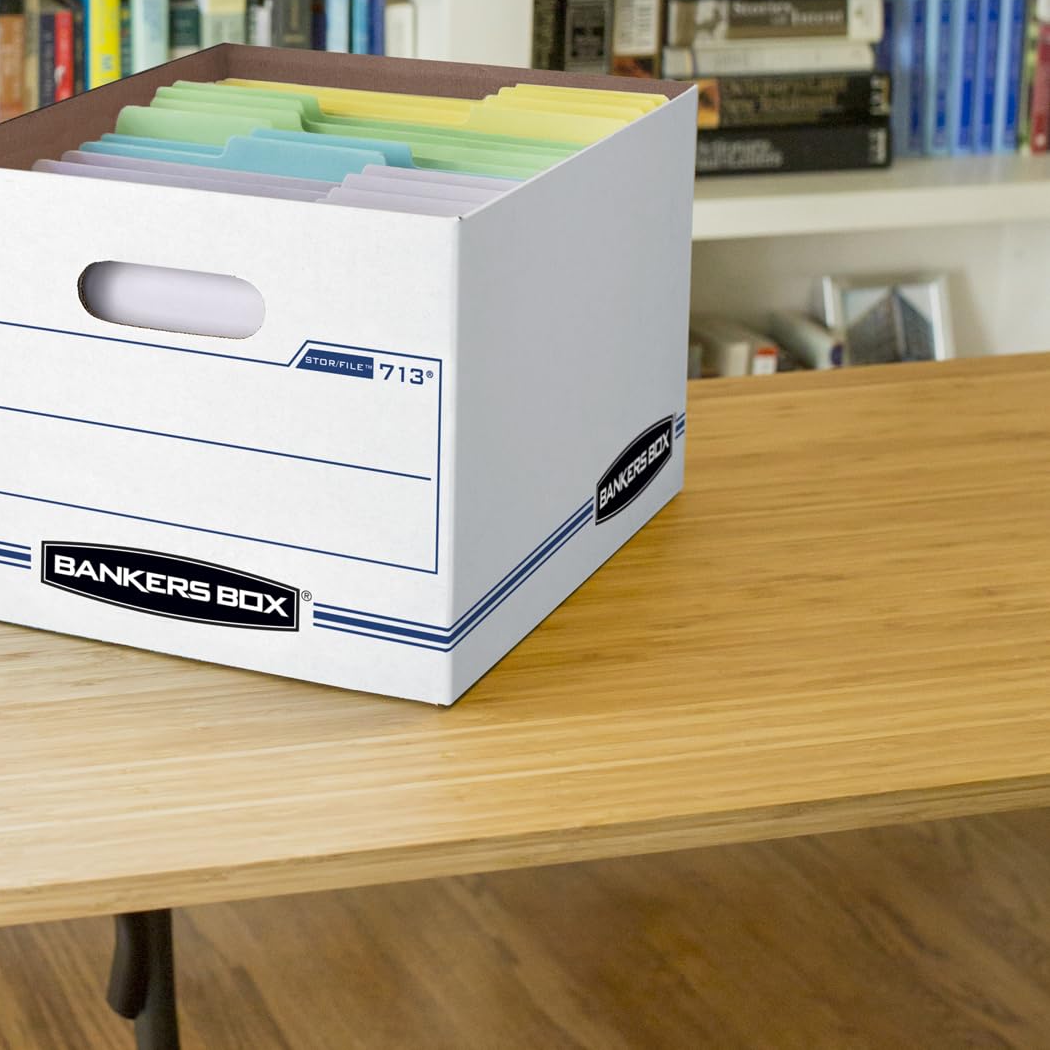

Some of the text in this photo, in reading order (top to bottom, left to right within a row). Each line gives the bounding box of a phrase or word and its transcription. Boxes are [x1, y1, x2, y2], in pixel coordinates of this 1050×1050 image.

[600, 429, 670, 510] BANKERS BOX
[54, 554, 290, 618] BANKERS BOX
